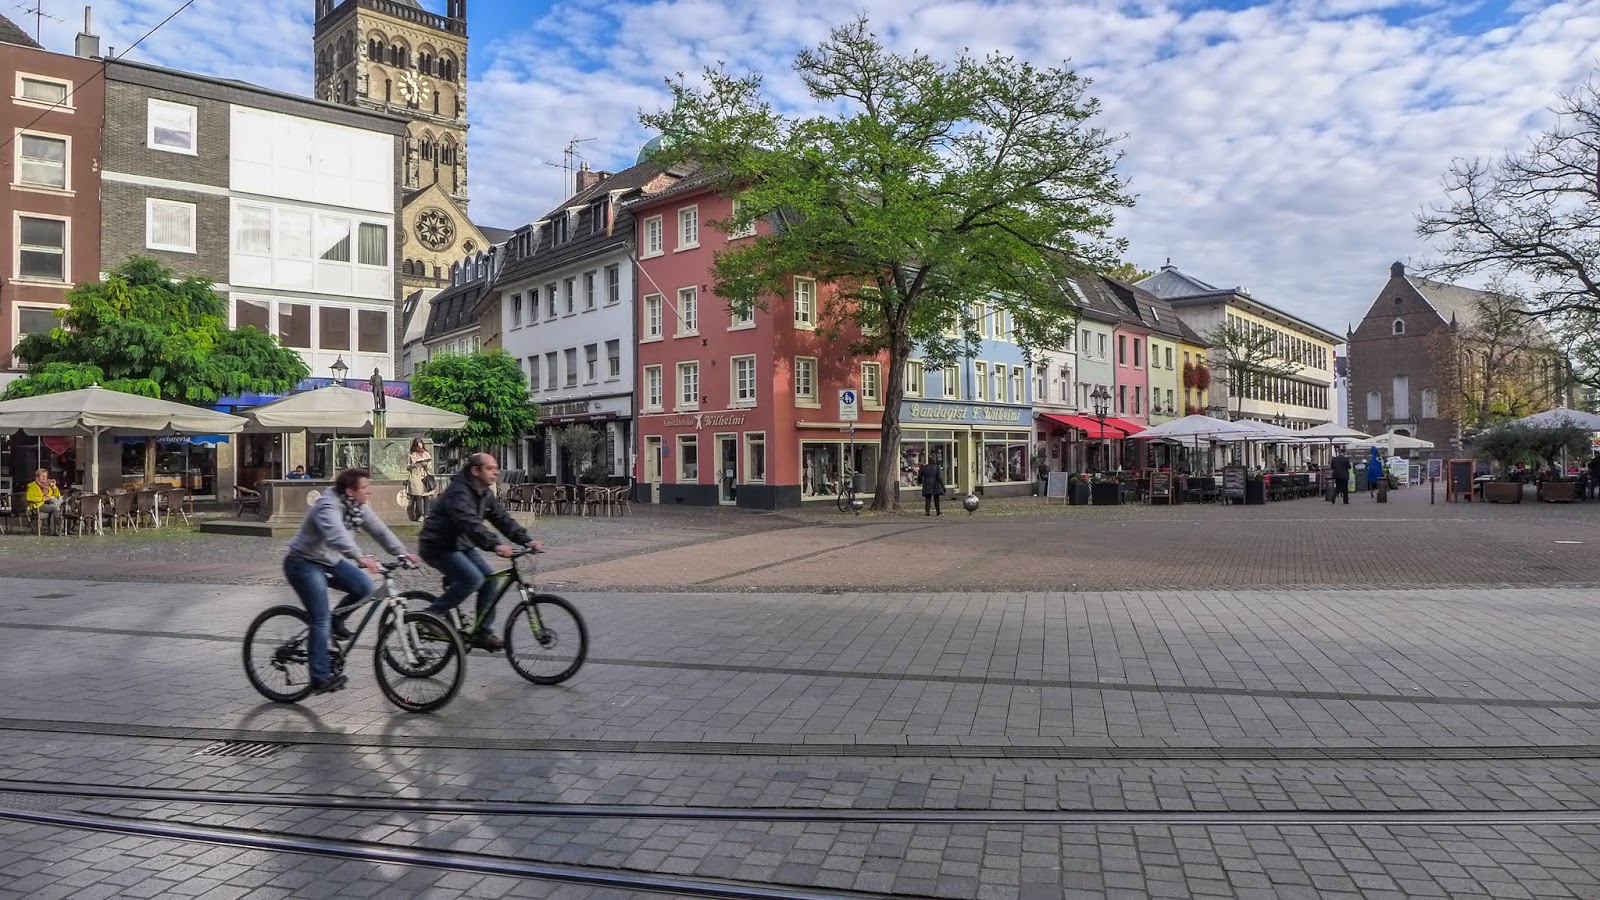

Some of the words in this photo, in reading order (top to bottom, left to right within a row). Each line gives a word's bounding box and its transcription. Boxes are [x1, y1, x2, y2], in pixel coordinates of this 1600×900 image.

[910, 402, 968, 421] Bandagist
[983, 406, 1020, 421] Wilhelmi
[704, 414, 746, 427] Wilhelmi
